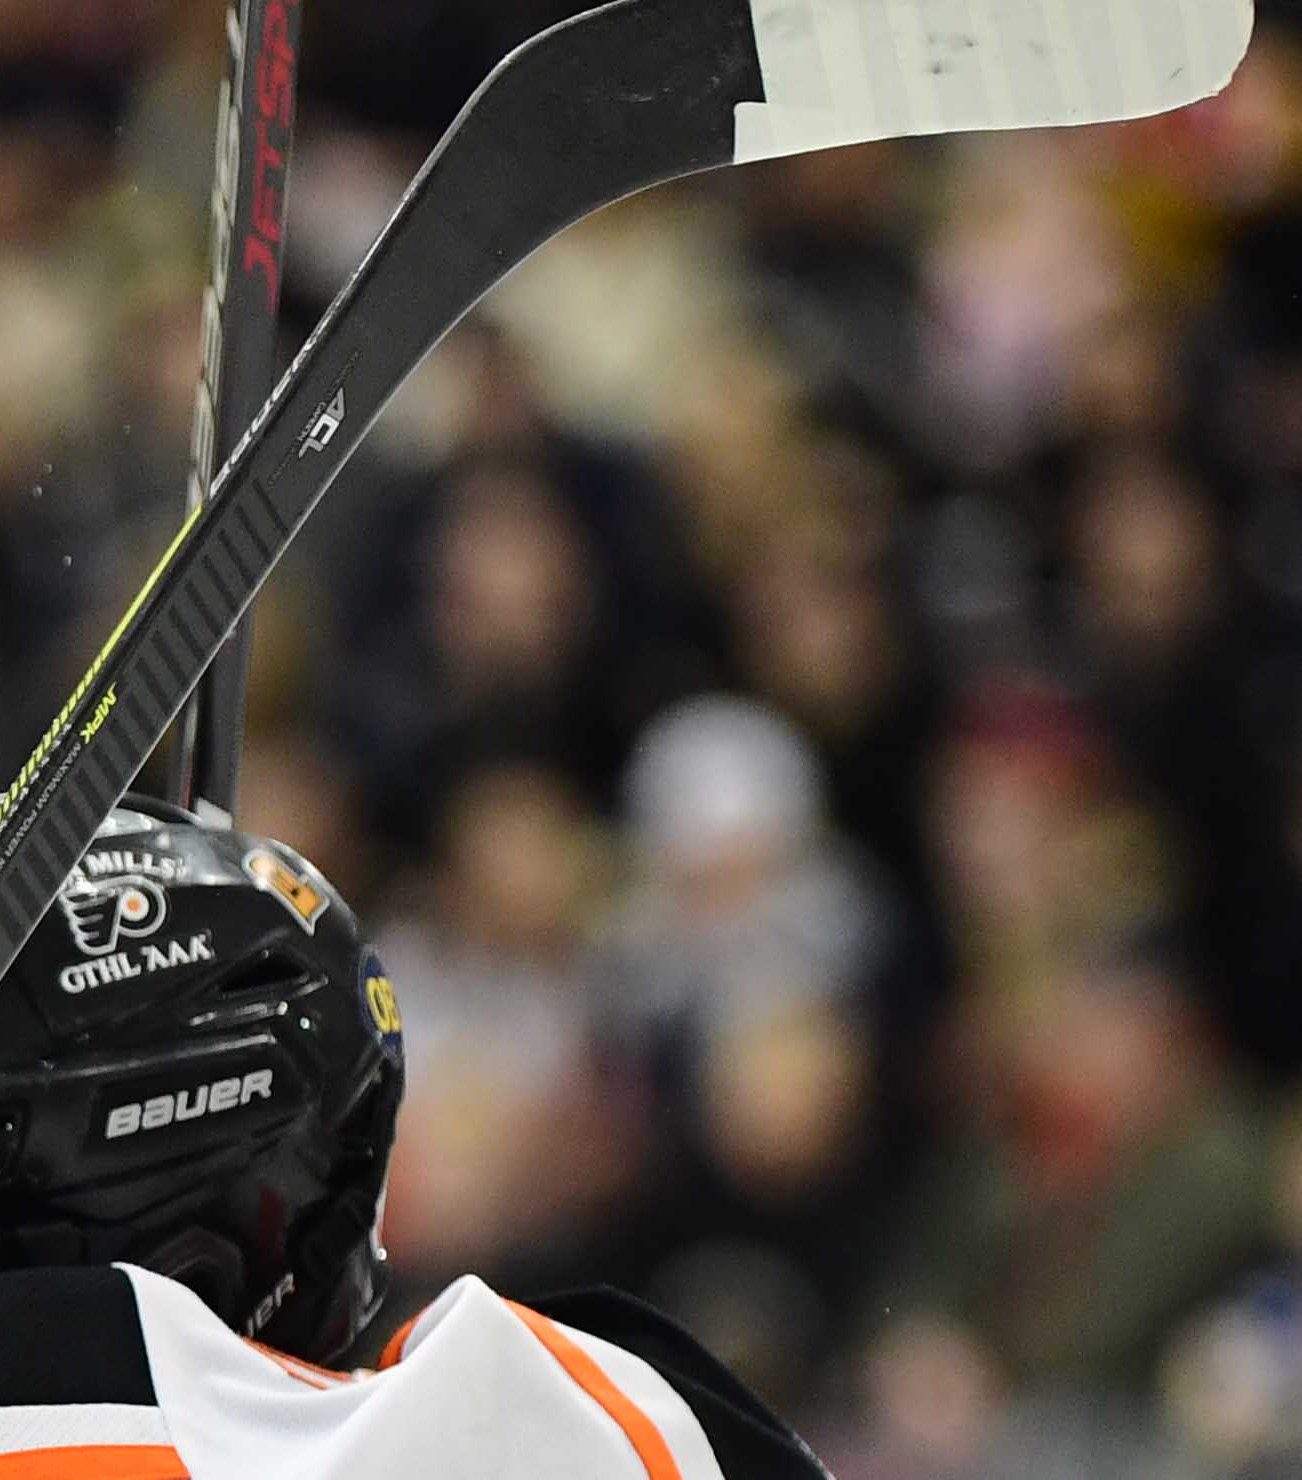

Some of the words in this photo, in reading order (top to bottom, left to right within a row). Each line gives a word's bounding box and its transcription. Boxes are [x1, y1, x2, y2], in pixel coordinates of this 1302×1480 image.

[243, 0, 298, 313] JETSP
[80, 681, 117, 744] MPK
[36, 742, 82, 810] MAXIMUM
[5, 809, 38, 858] POWER
[59, 952, 141, 994] GTHL
